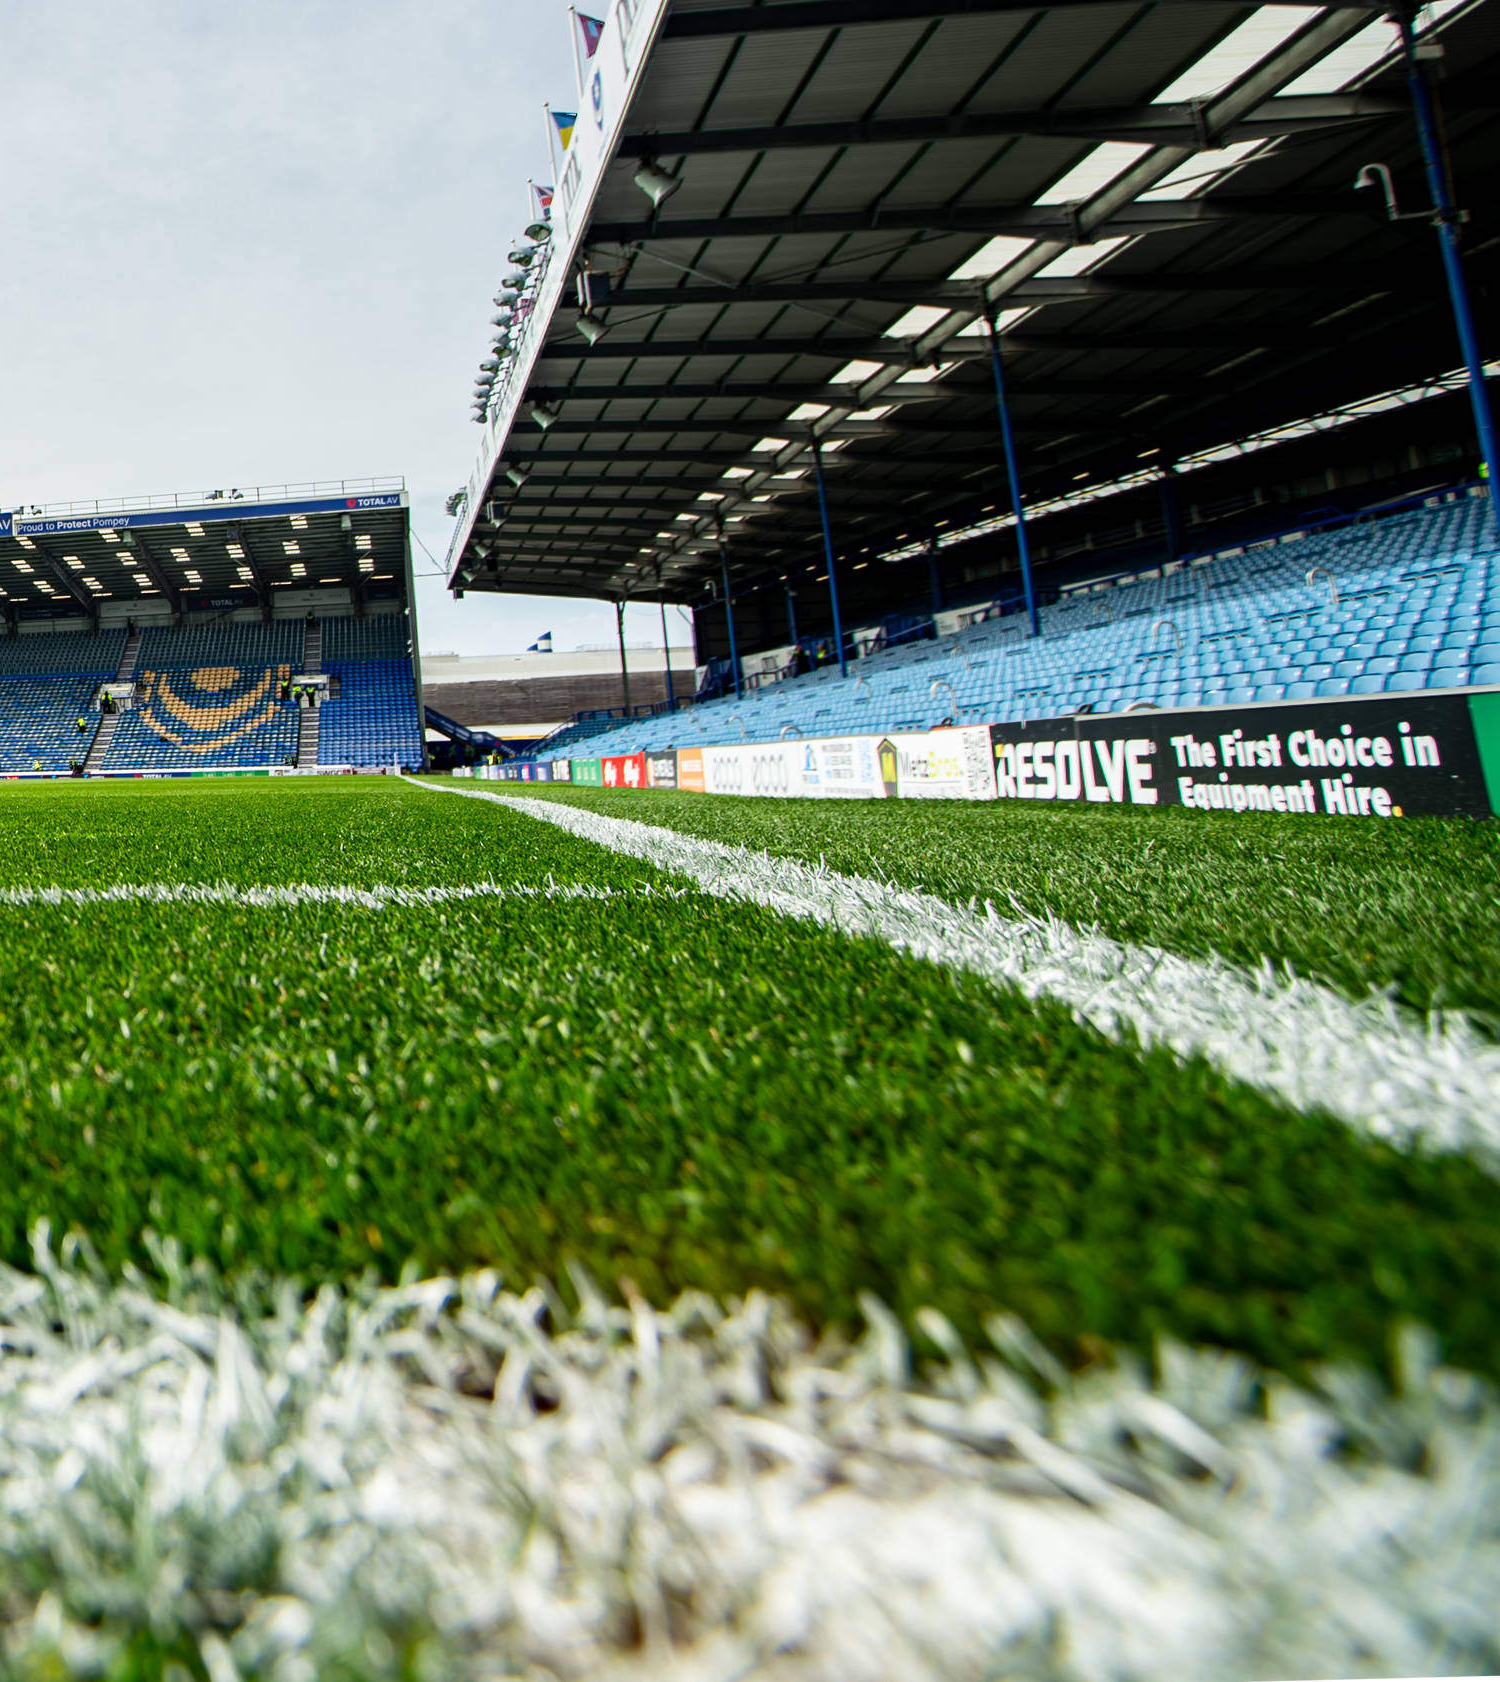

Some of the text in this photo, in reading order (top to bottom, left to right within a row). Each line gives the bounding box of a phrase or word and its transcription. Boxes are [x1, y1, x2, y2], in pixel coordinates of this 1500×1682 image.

[18, 517, 130, 532] Proud to Protect Pompey
[1170, 721, 1441, 768] The First Choice in
[1177, 772, 1403, 817] Equipment Hire.
